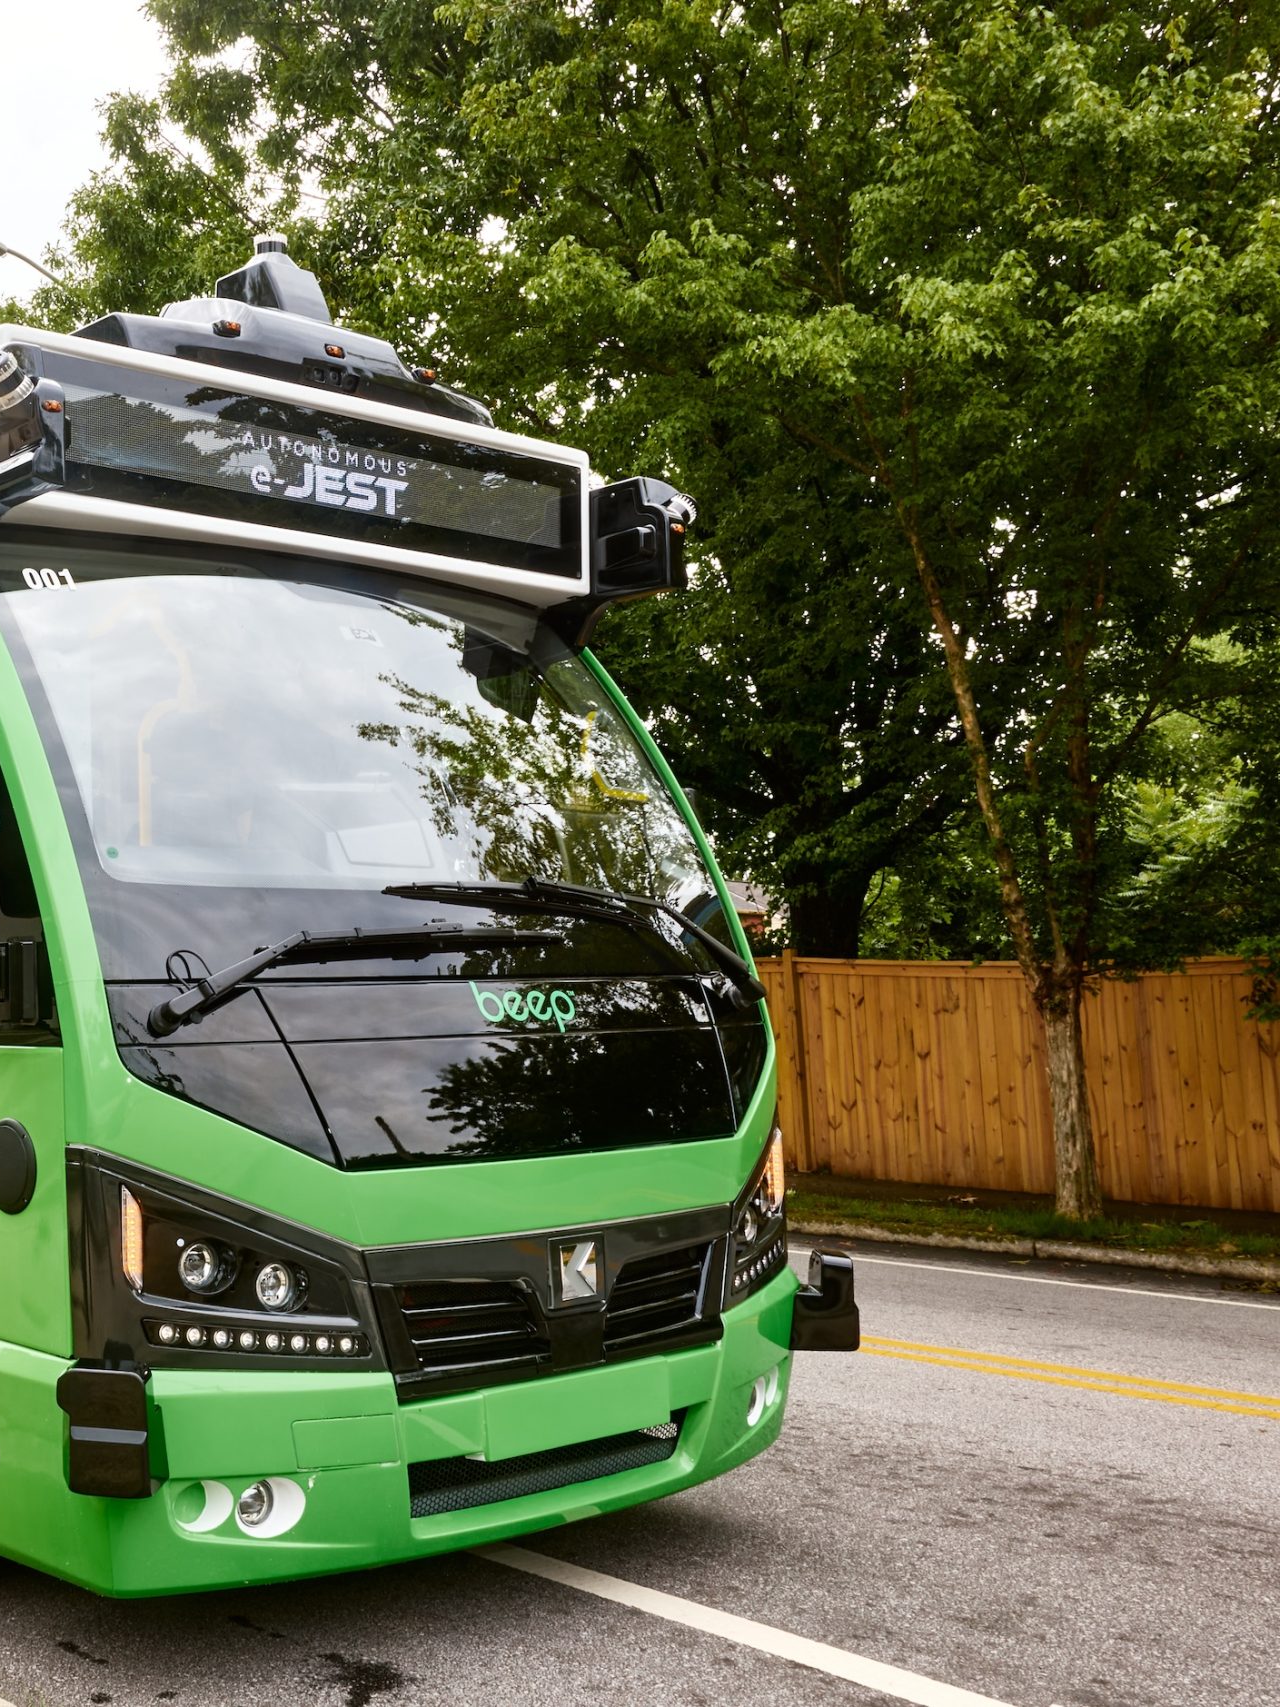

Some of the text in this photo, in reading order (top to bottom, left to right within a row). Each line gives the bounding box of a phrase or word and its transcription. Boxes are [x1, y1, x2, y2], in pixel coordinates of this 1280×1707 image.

[242, 430, 408, 477] AUTONOMOUS
[250, 463, 410, 516] e-JEST
[21, 567, 78, 592] 001
[469, 980, 576, 1034] beep
